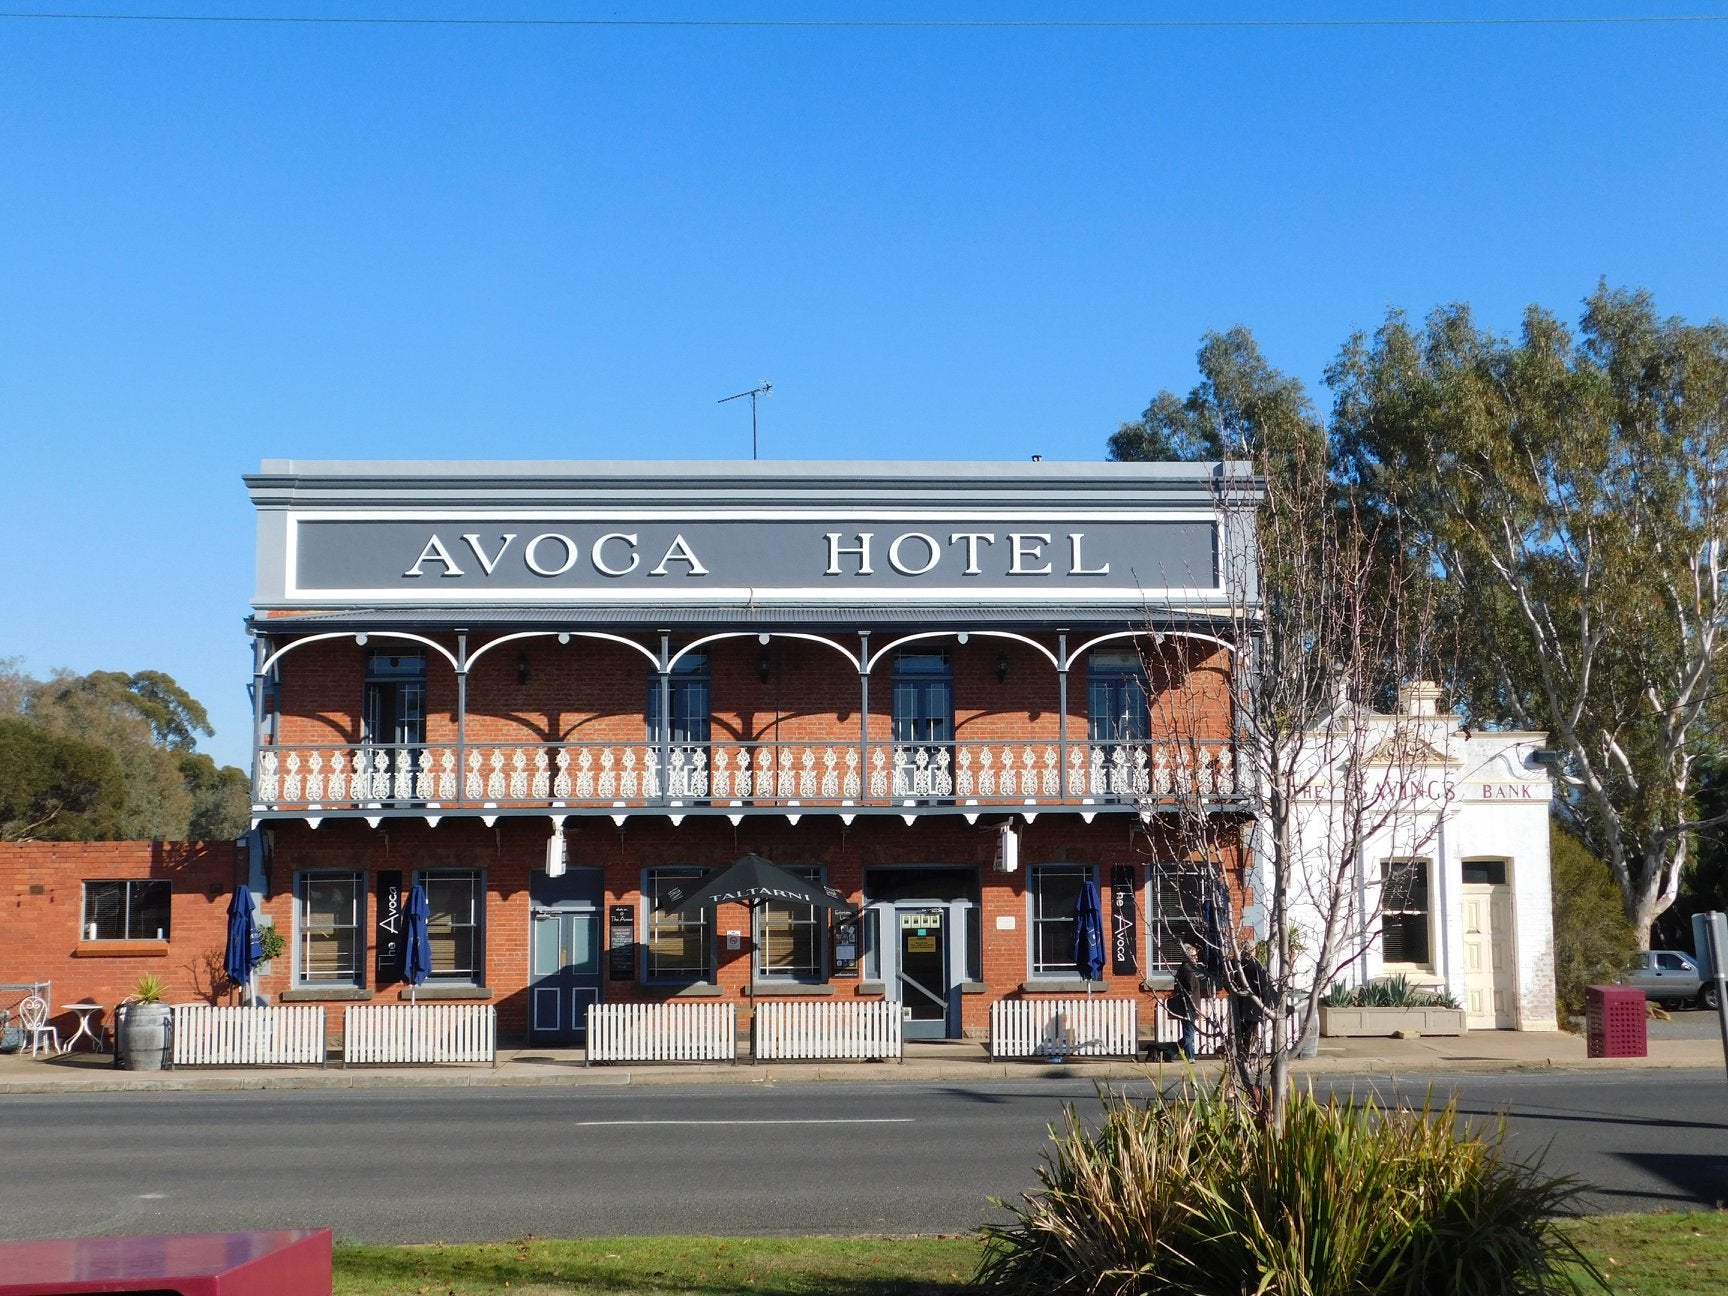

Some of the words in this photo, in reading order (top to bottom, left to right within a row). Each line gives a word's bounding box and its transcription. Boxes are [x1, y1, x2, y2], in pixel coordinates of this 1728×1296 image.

[404, 532, 710, 577] AVOCA
[823, 531, 1111, 577] HOTEL
[1482, 784, 1532, 799] BANK
[709, 887, 811, 902] TALTARNI
[1114, 878, 1133, 907] The
[379, 886, 400, 934] Avoca
[1114, 914, 1134, 962] Avoca
[378, 942, 396, 972] The
